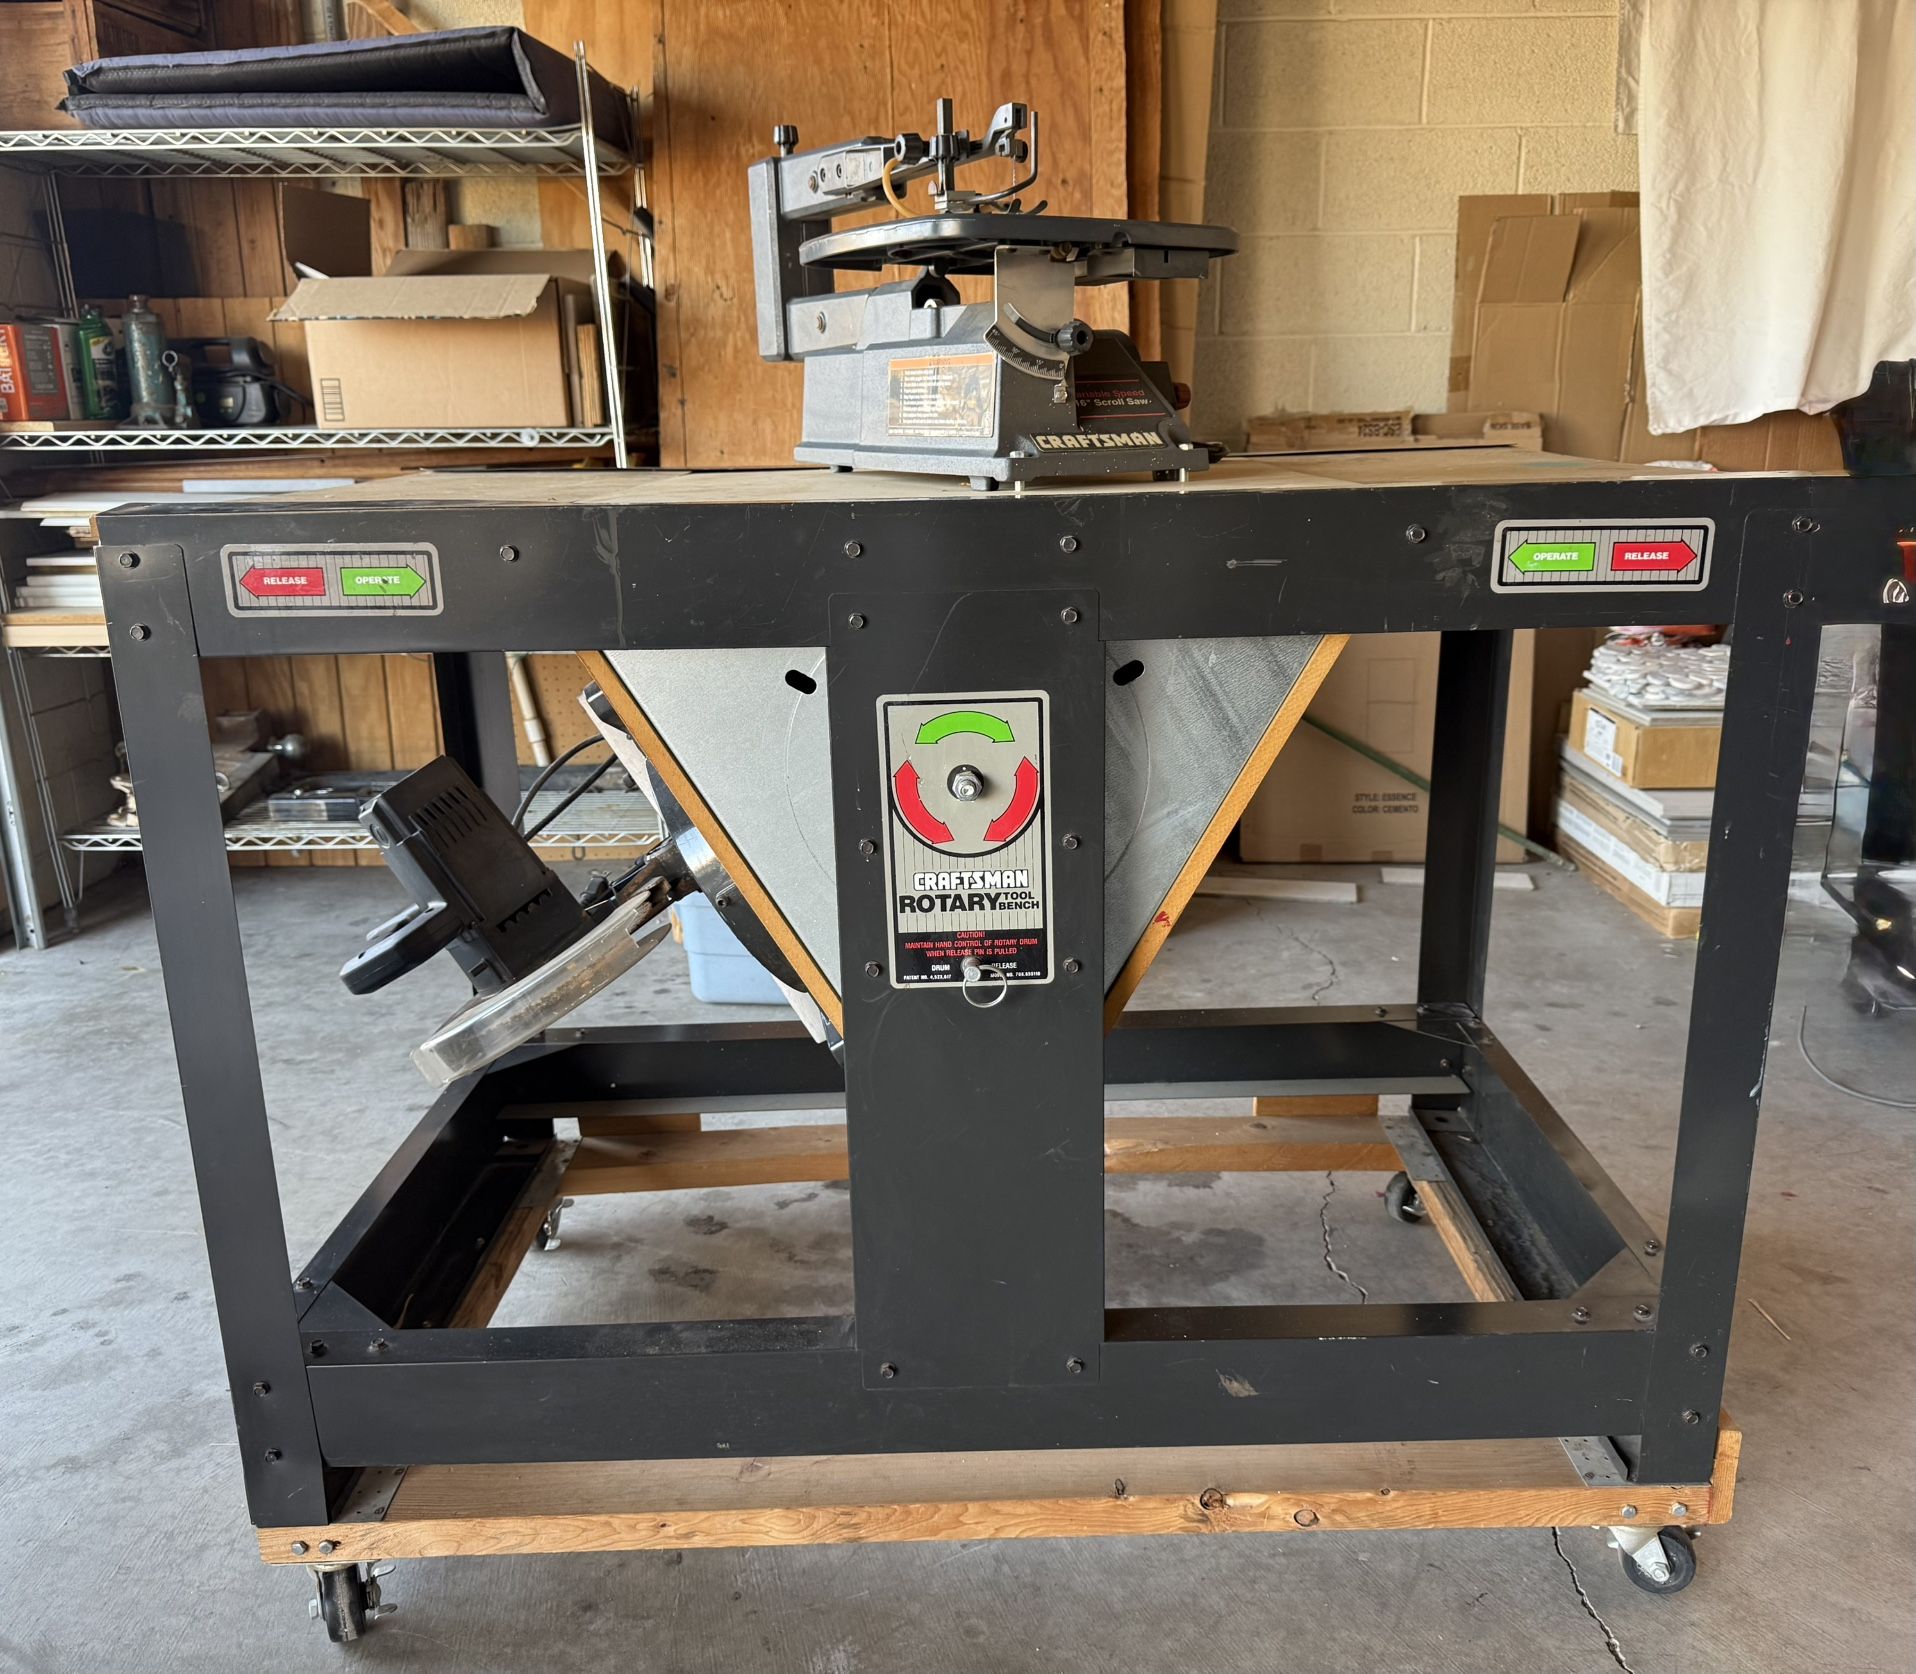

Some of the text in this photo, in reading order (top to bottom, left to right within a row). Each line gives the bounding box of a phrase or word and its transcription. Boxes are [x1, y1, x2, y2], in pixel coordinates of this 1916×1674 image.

[1076, 389, 1145, 398] ariable Speed
[1094, 398, 1125, 406] Scroll
[1126, 397, 1148, 405] Saw
[1035, 431, 1164, 449] CRAFTSMAN
[1533, 552, 1579, 560] OPERATE
[1624, 552, 1669, 560] RELEASE
[263, 576, 307, 585] RELEASE
[913, 869, 1029, 891] CRAFTSMAN
[1003, 891, 1035, 901] TOOL
[899, 893, 1002, 913] ROTARY
[999, 901, 1040, 910] BENCH
[956, 931, 986, 939] CAUTION!
[904, 941, 934, 949] MAINTAIN
[994, 947, 1017, 955] PULLED
